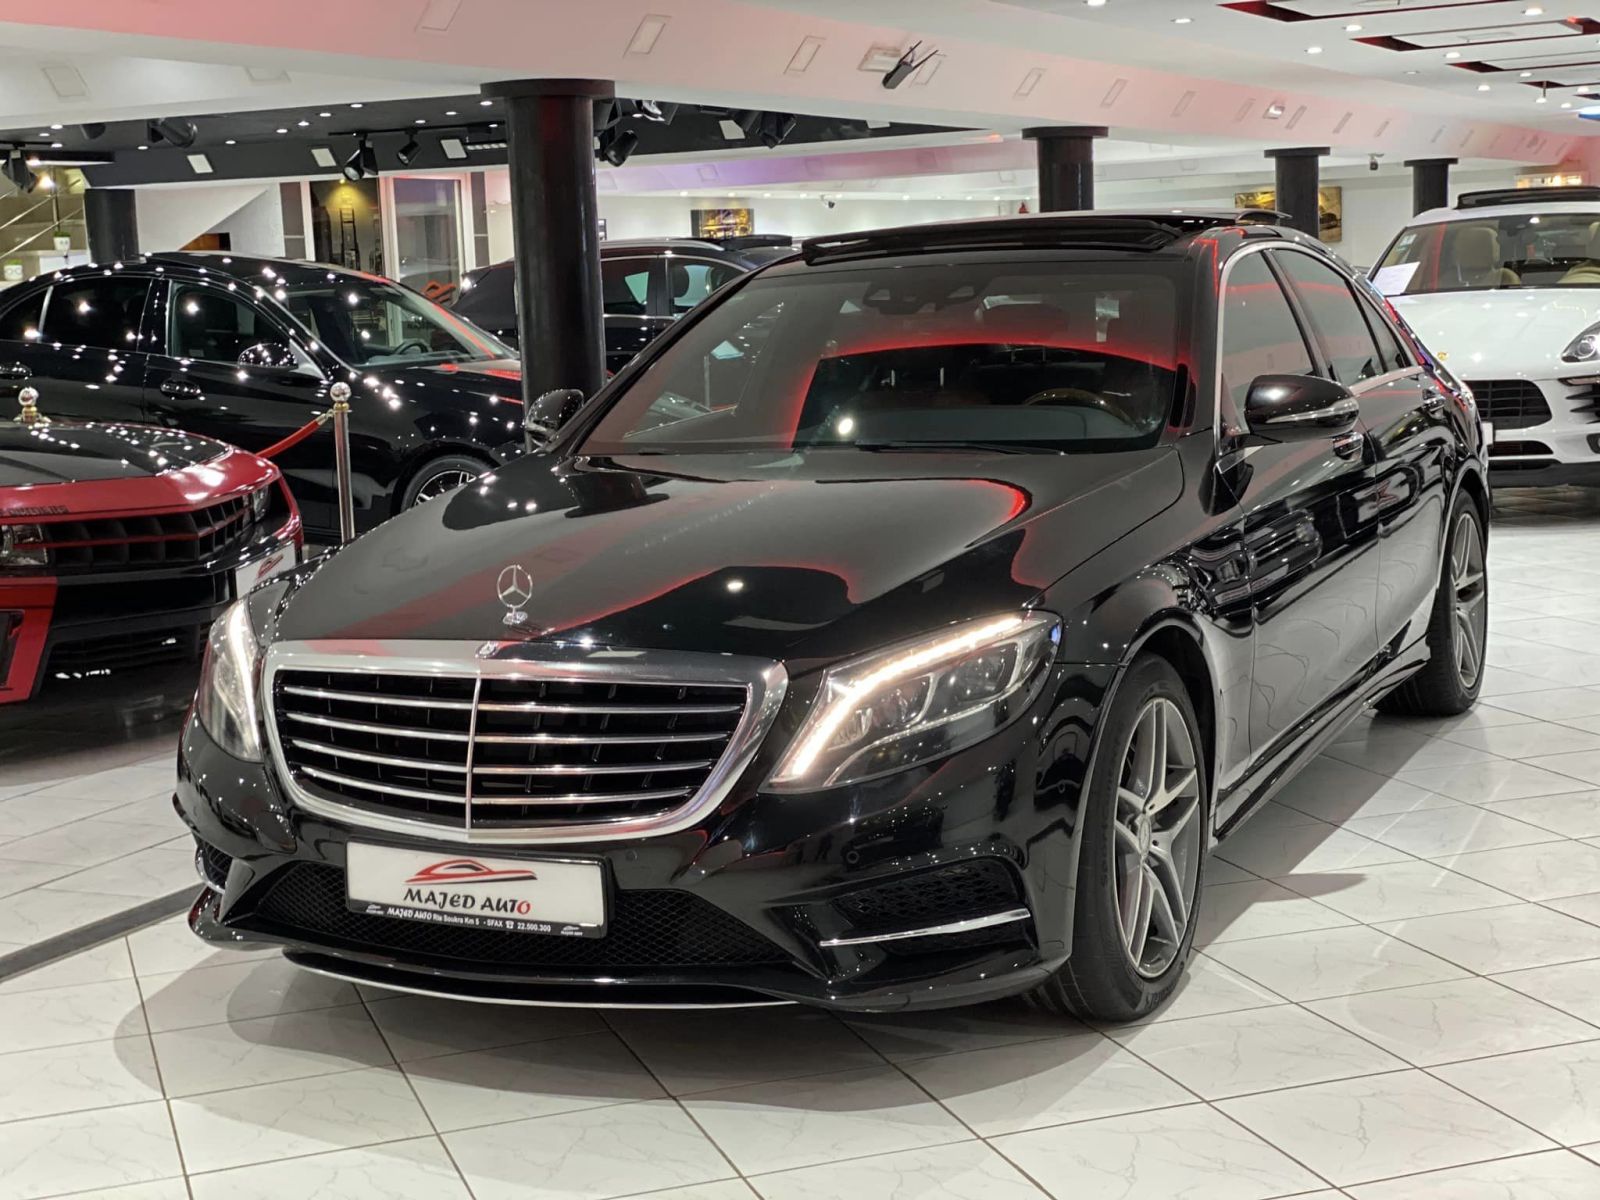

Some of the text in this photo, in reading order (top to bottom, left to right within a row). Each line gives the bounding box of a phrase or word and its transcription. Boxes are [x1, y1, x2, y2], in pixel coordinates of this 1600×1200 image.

[404, 888, 531, 915] MAJED AUTO
[387, 907, 413, 918] MAJED
[414, 911, 432, 920] AUTO
[487, 919, 503, 927] SFAX
